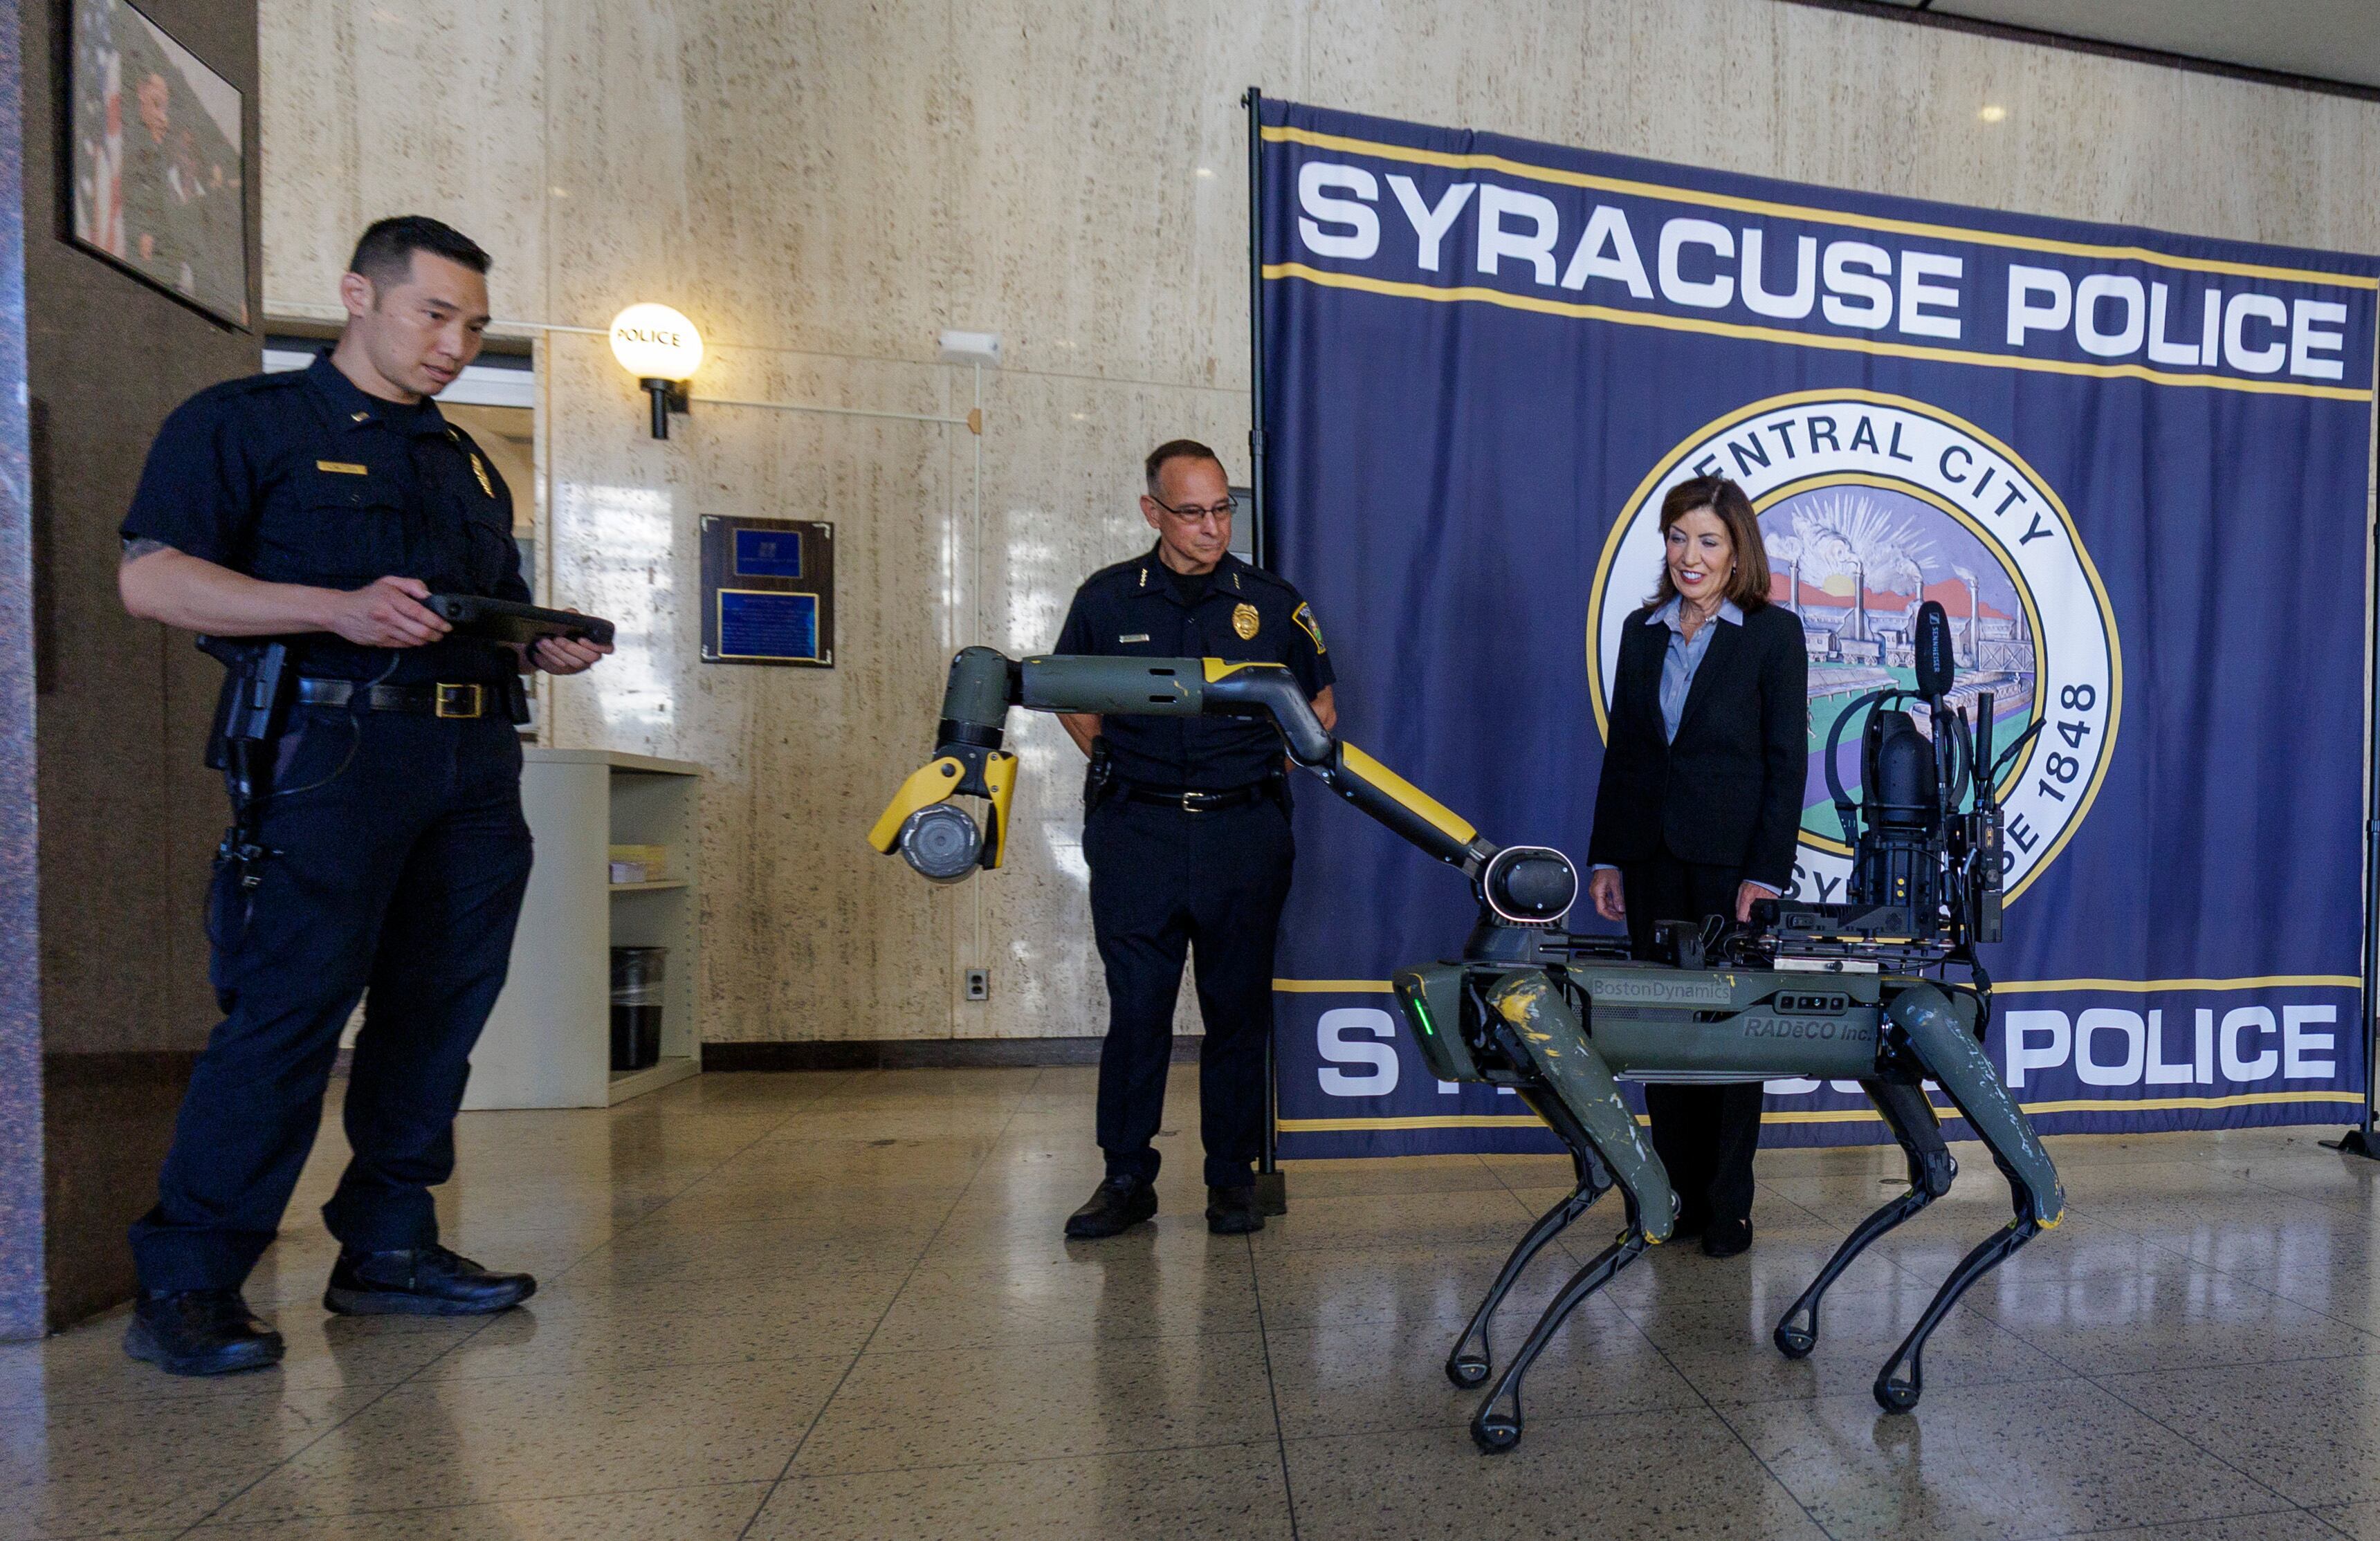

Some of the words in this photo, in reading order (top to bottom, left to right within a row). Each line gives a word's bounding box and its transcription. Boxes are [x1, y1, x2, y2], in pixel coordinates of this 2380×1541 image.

[1298, 161, 1963, 339] SYRACUSE
[2007, 264, 2347, 380] POLICE
[1692, 415, 1913, 478] ENTRAL
[1939, 445, 2055, 547] CITY
[1932, 626, 1941, 672] SENNHEISER
[2038, 684, 2096, 802] 1848
[1840, 1024, 1871, 1041] Inc.
[2006, 1005, 2336, 1088] POLICE
